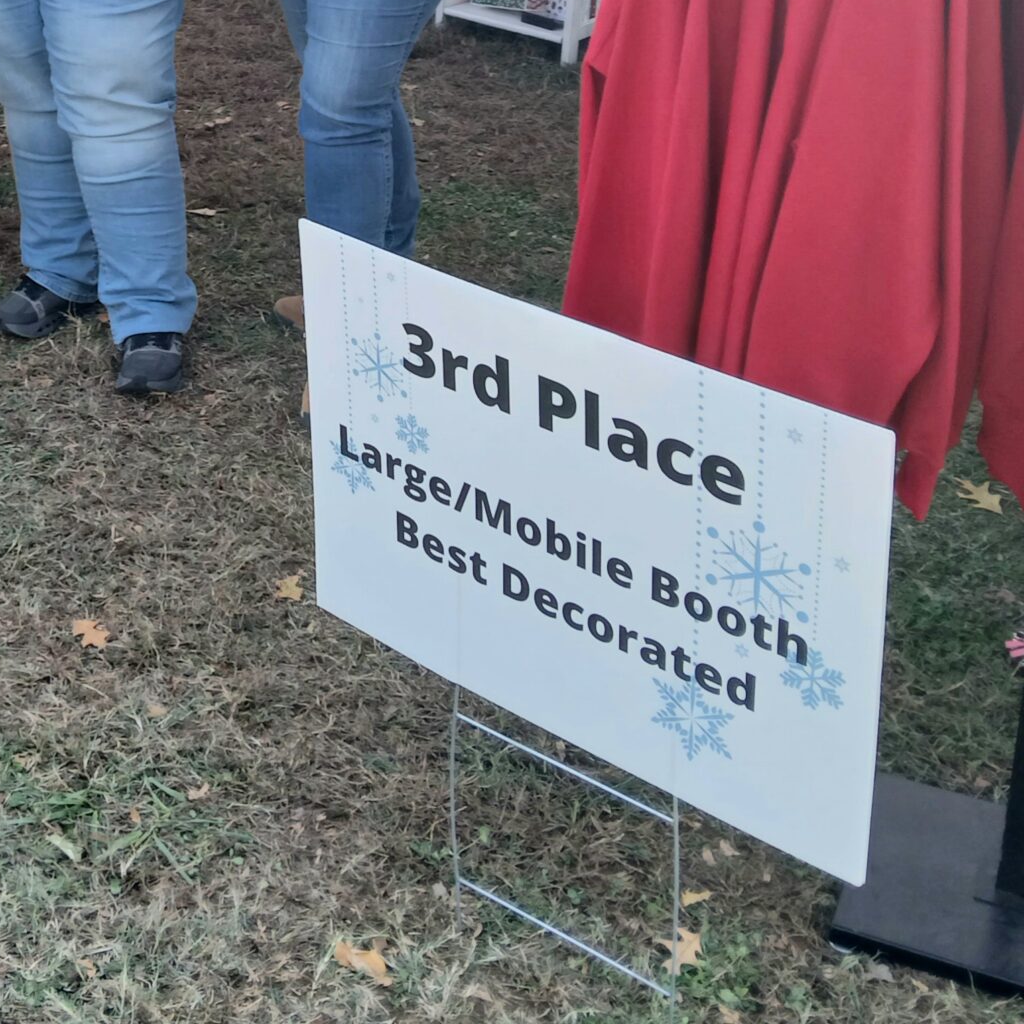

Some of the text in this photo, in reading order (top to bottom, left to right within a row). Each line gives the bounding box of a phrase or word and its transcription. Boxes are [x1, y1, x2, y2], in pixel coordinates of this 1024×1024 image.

[402, 322, 746, 506] 3rd Place
[339, 424, 808, 667] Large/Mobile Booth
[396, 512, 757, 712] Best Decorated
